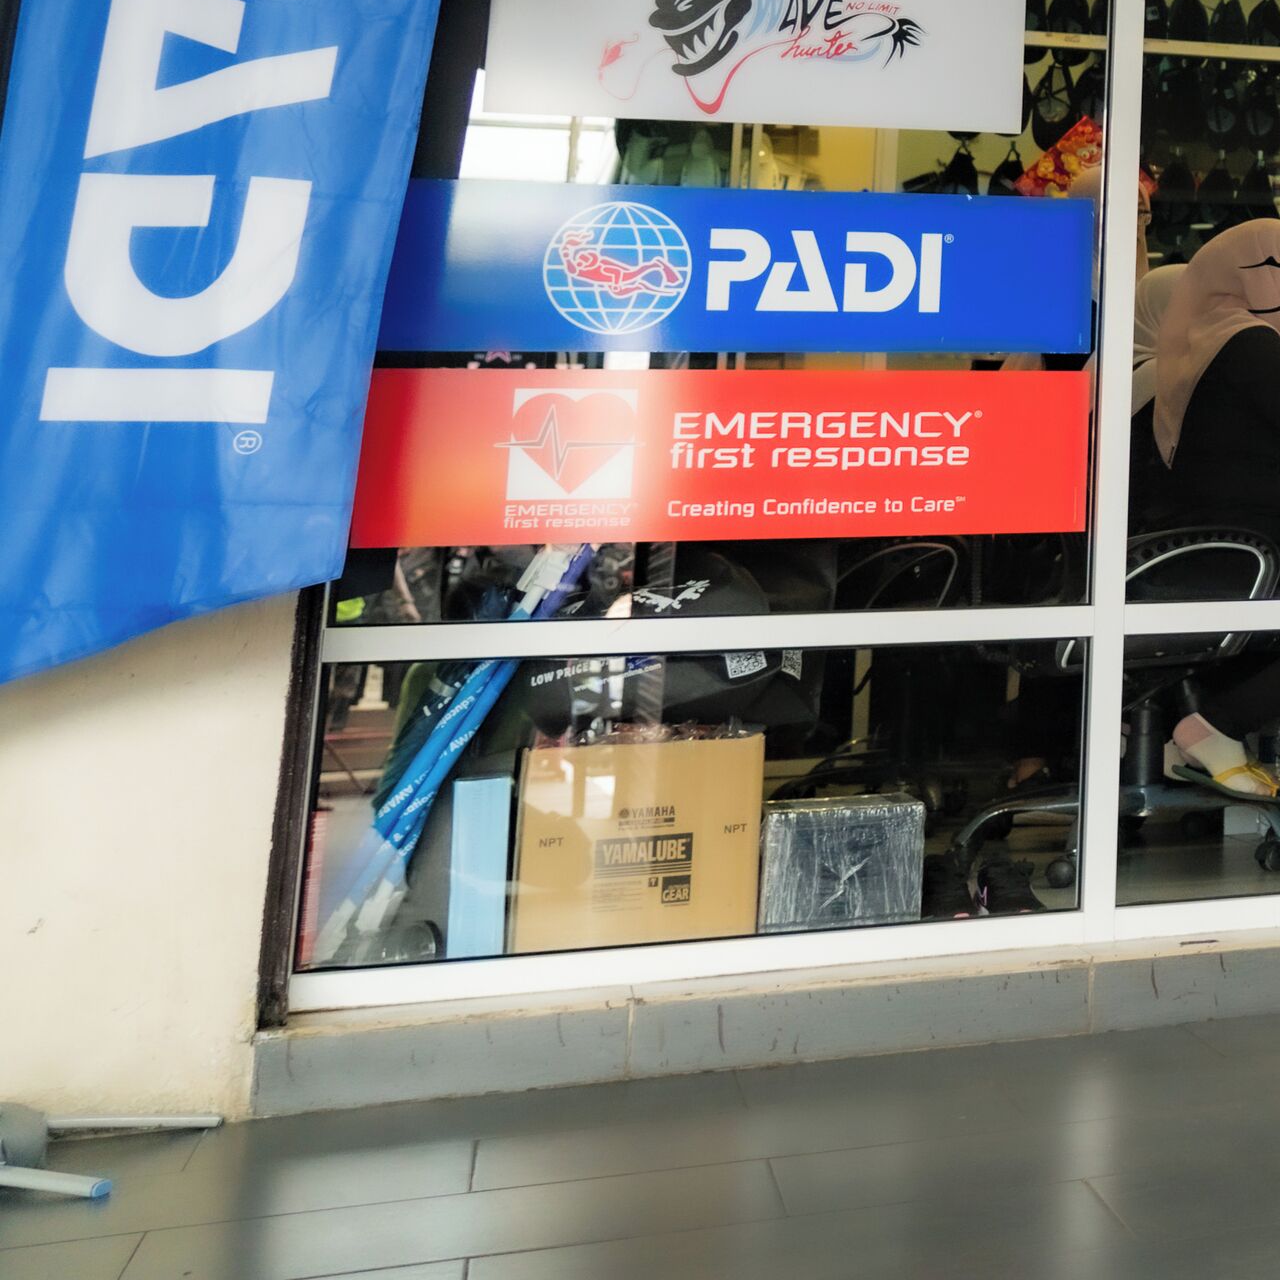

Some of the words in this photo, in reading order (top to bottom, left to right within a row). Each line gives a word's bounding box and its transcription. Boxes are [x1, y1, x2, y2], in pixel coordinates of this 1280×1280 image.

[705, 228, 943, 314] PADI
[671, 411, 972, 440] EMERGENCY
[669, 443, 761, 470] first
[770, 445, 971, 472] response
[504, 504, 632, 517] EMERGENCY
[667, 497, 756, 520] Creating
[763, 496, 878, 516] Confidence
[884, 497, 904, 514] to
[503, 516, 539, 528] first
[542, 515, 632, 529] response
[531, 671, 554, 687] LOW
[632, 806, 676, 819] YAMAHA
[724, 823, 748, 835] NPT
[539, 837, 565, 848] NPT
[603, 838, 687, 865] YAMALUBE
[662, 888, 690, 902] GEAR
